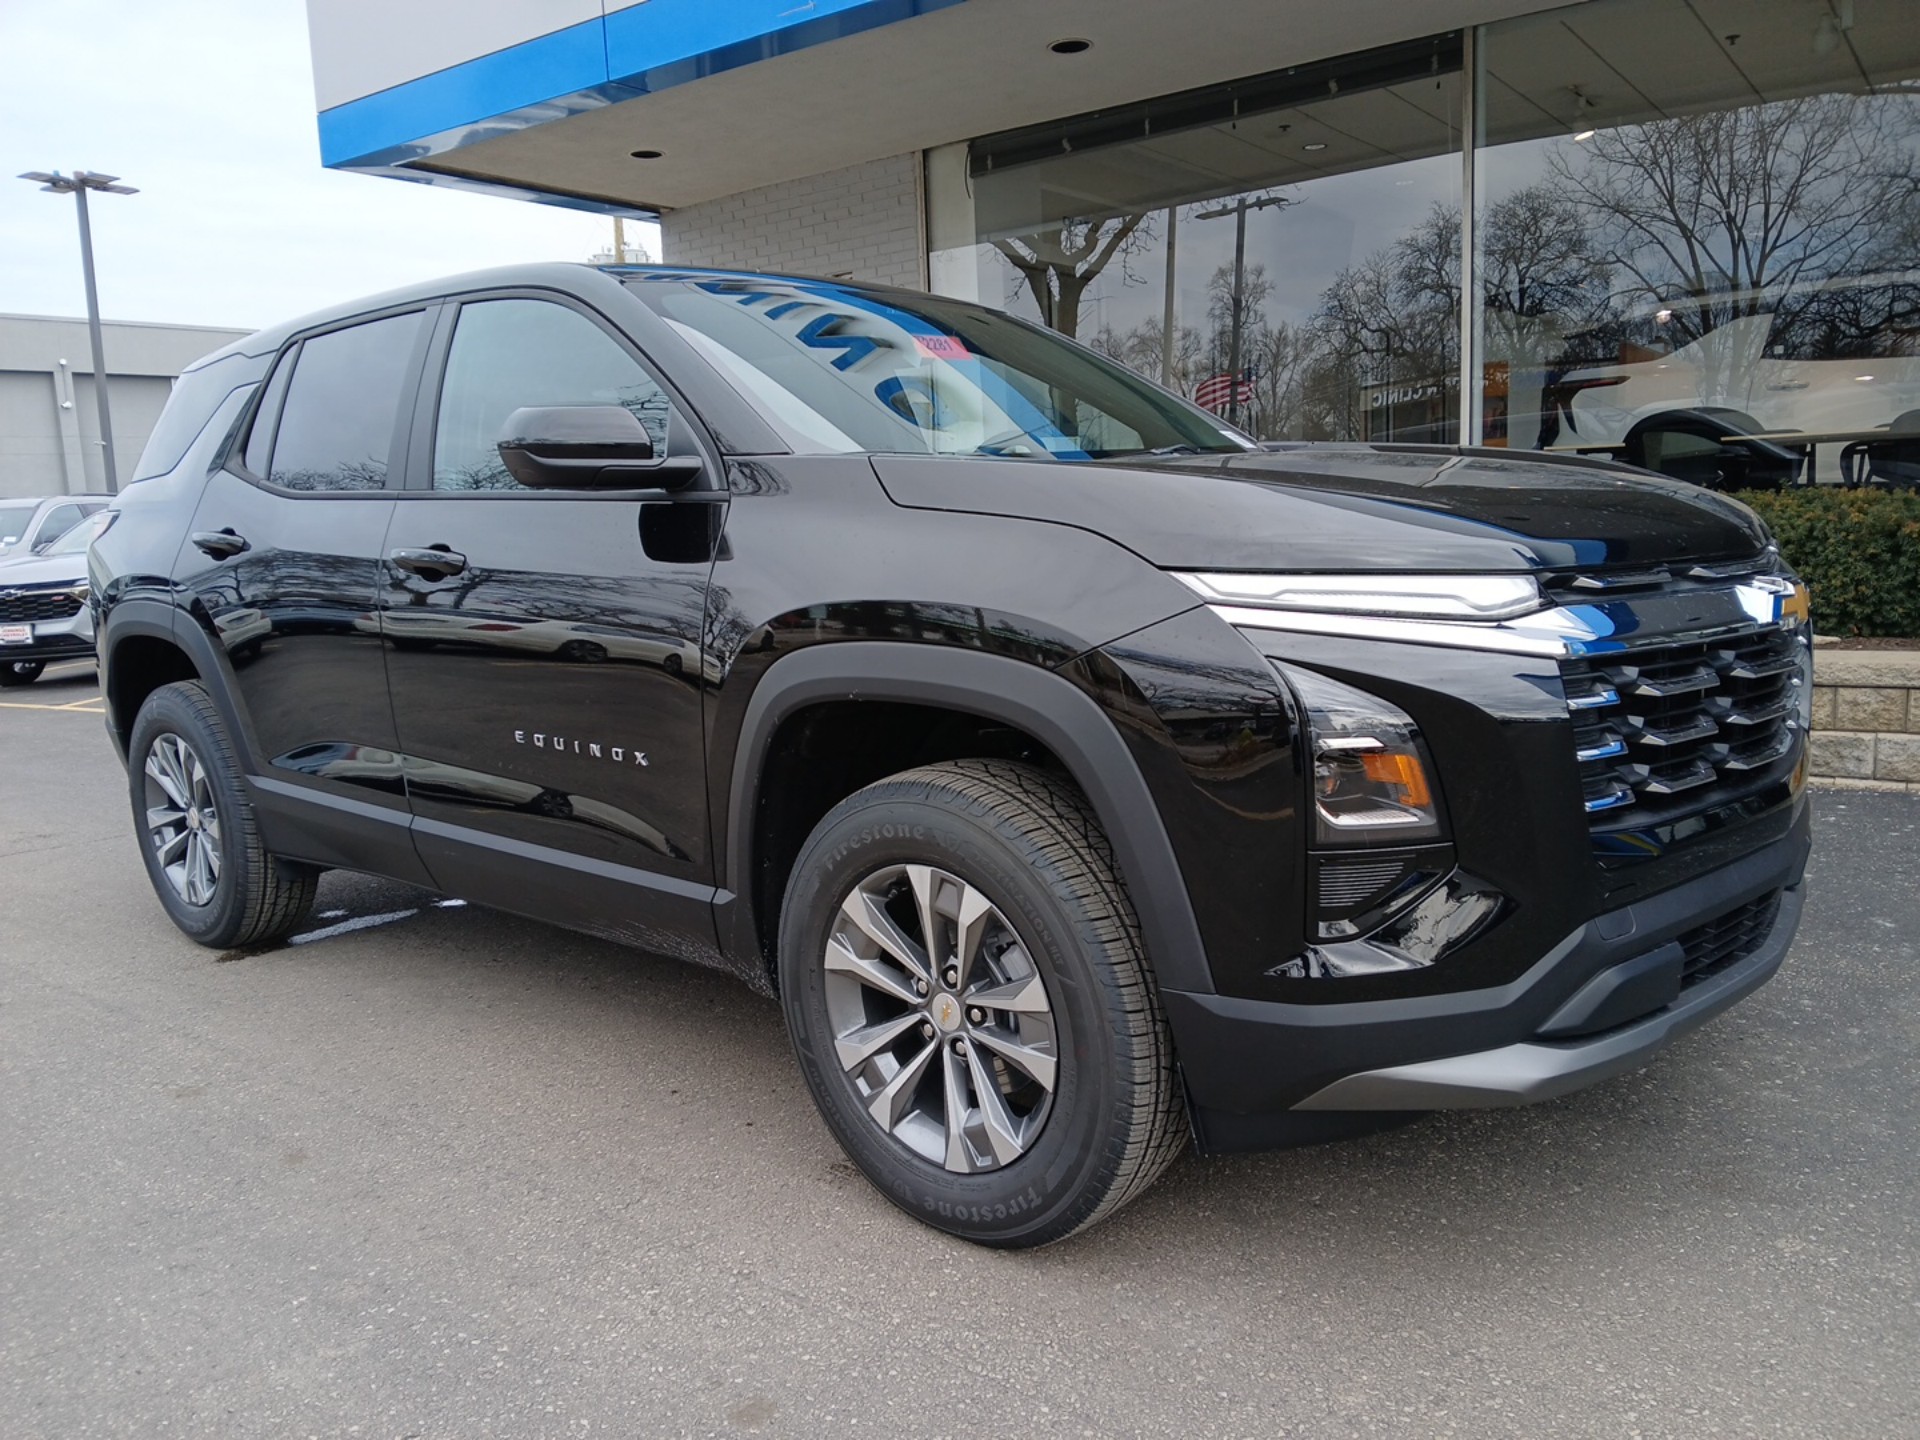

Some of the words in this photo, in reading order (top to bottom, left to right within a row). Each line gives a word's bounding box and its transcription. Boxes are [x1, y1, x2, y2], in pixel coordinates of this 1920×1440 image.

[514, 730, 649, 766] EQUINOX
[822, 823, 925, 871] Firestone
[923, 1185, 1043, 1223] Firestone
